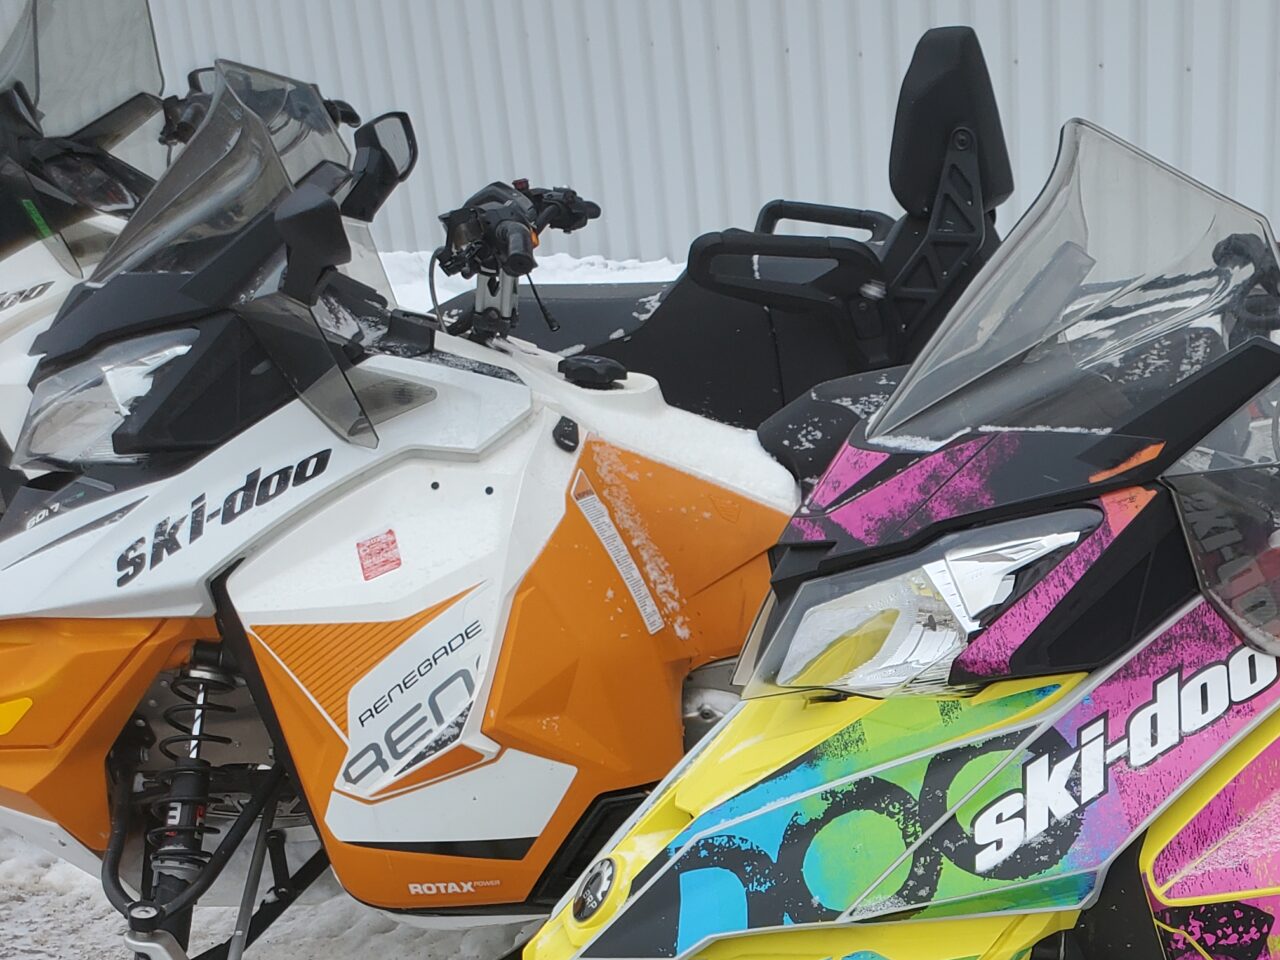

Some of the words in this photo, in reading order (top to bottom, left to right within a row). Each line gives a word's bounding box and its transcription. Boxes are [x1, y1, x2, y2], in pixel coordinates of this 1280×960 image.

[358, 619, 483, 728] RENEGADE
[407, 881, 476, 895] ROTAX
[582, 889, 598, 909] BRP
